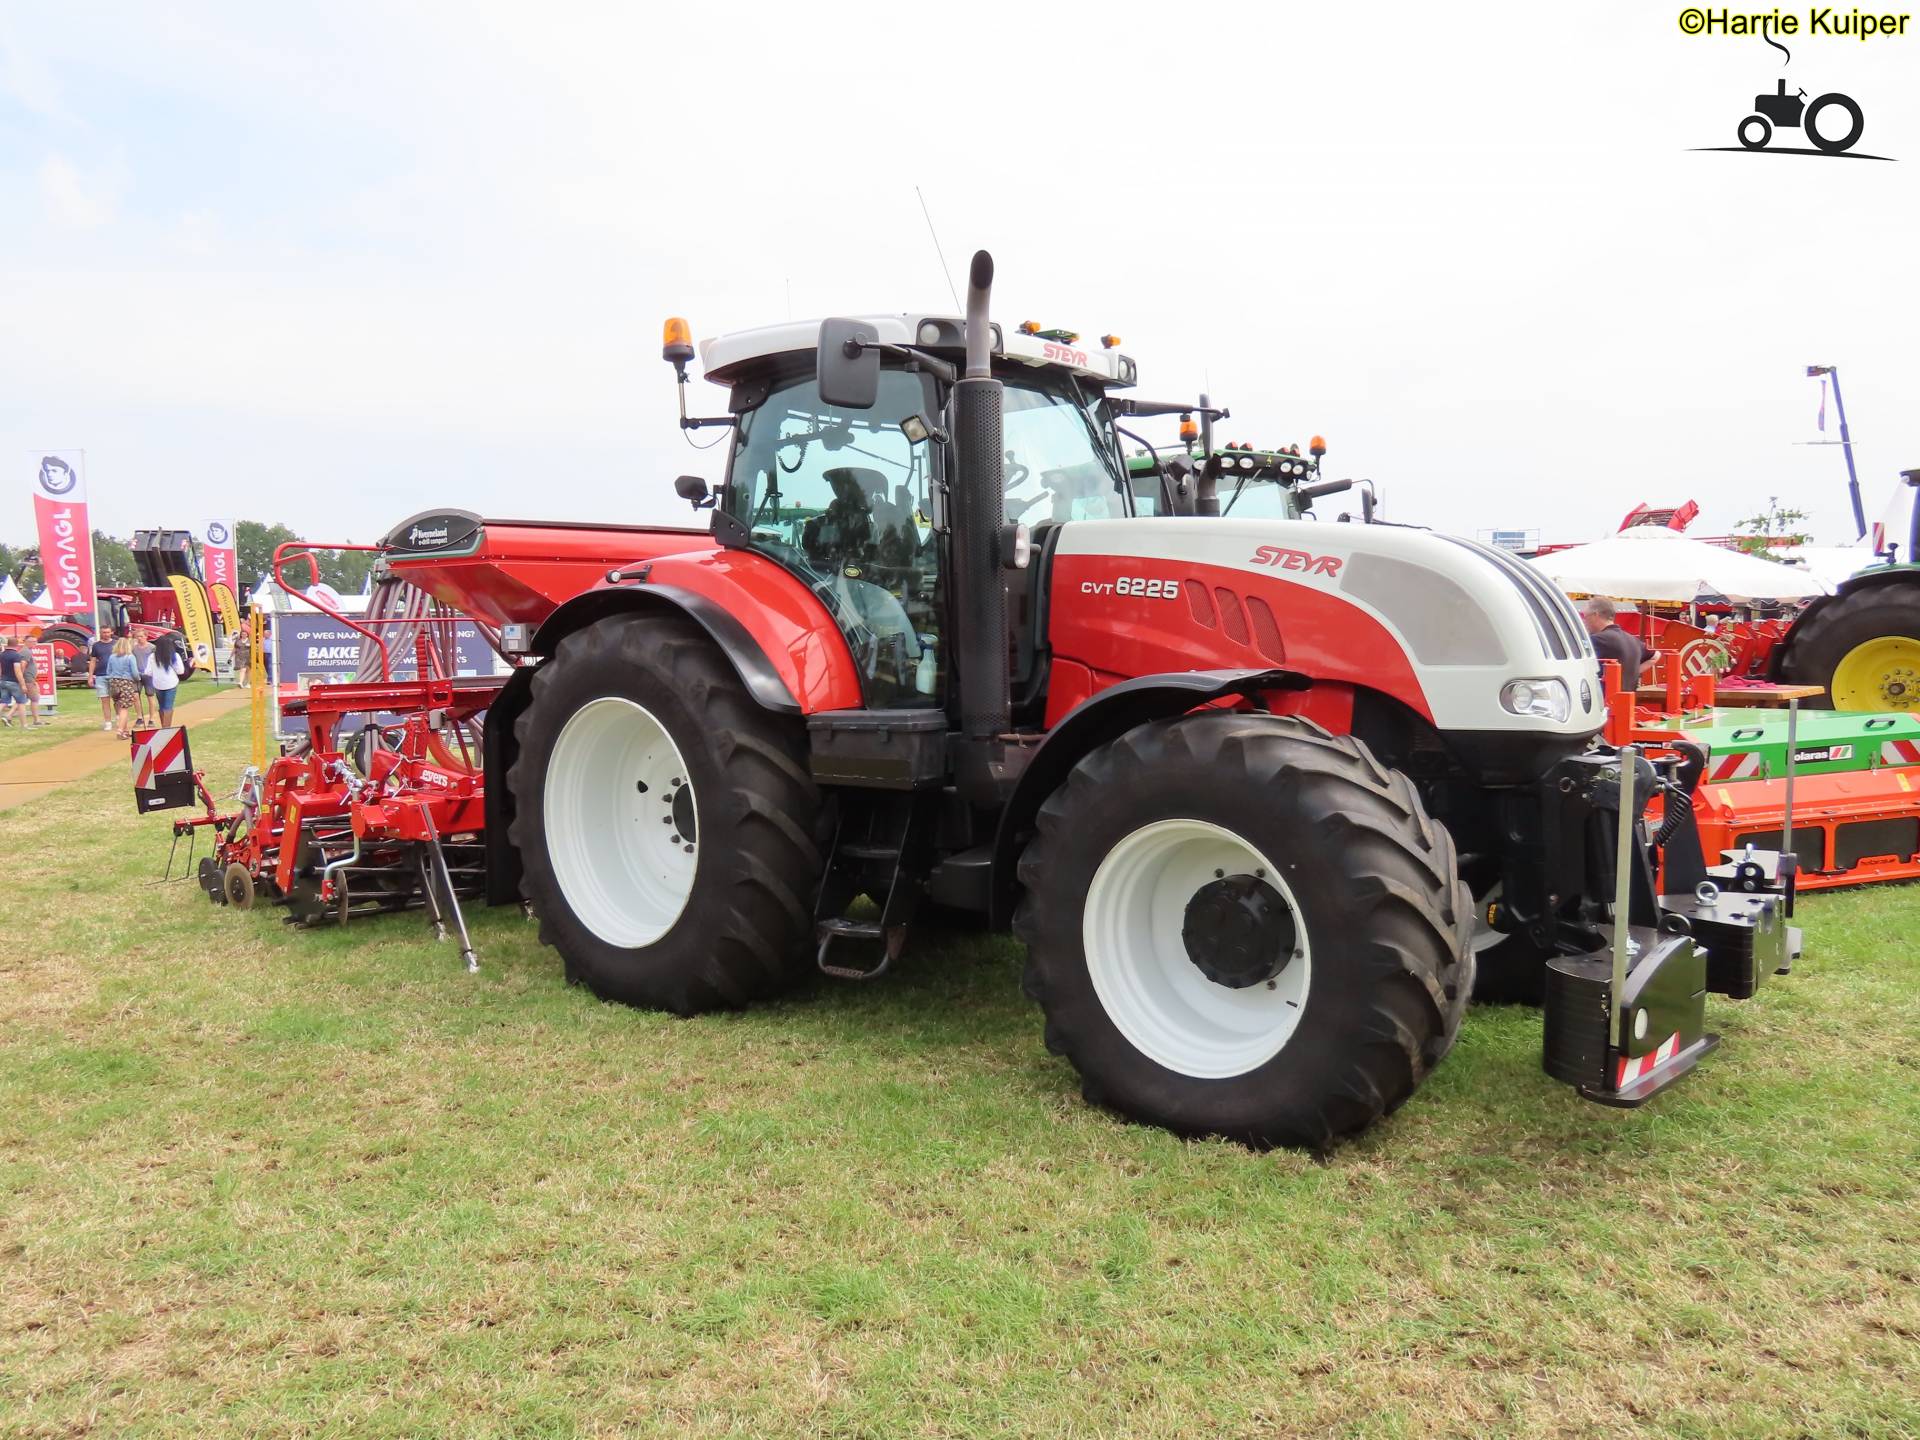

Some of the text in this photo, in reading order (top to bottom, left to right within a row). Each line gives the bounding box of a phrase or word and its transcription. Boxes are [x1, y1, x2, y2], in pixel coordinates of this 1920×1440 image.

[1043, 342, 1088, 367] STEYR
[1249, 545, 1343, 577] STEYR
[1081, 576, 1179, 600] CVT 6225
[297, 632, 311, 640] OP
[312, 632, 335, 640] WEG
[308, 646, 360, 659] BAKKE
[1793, 750, 1829, 761] olaras
